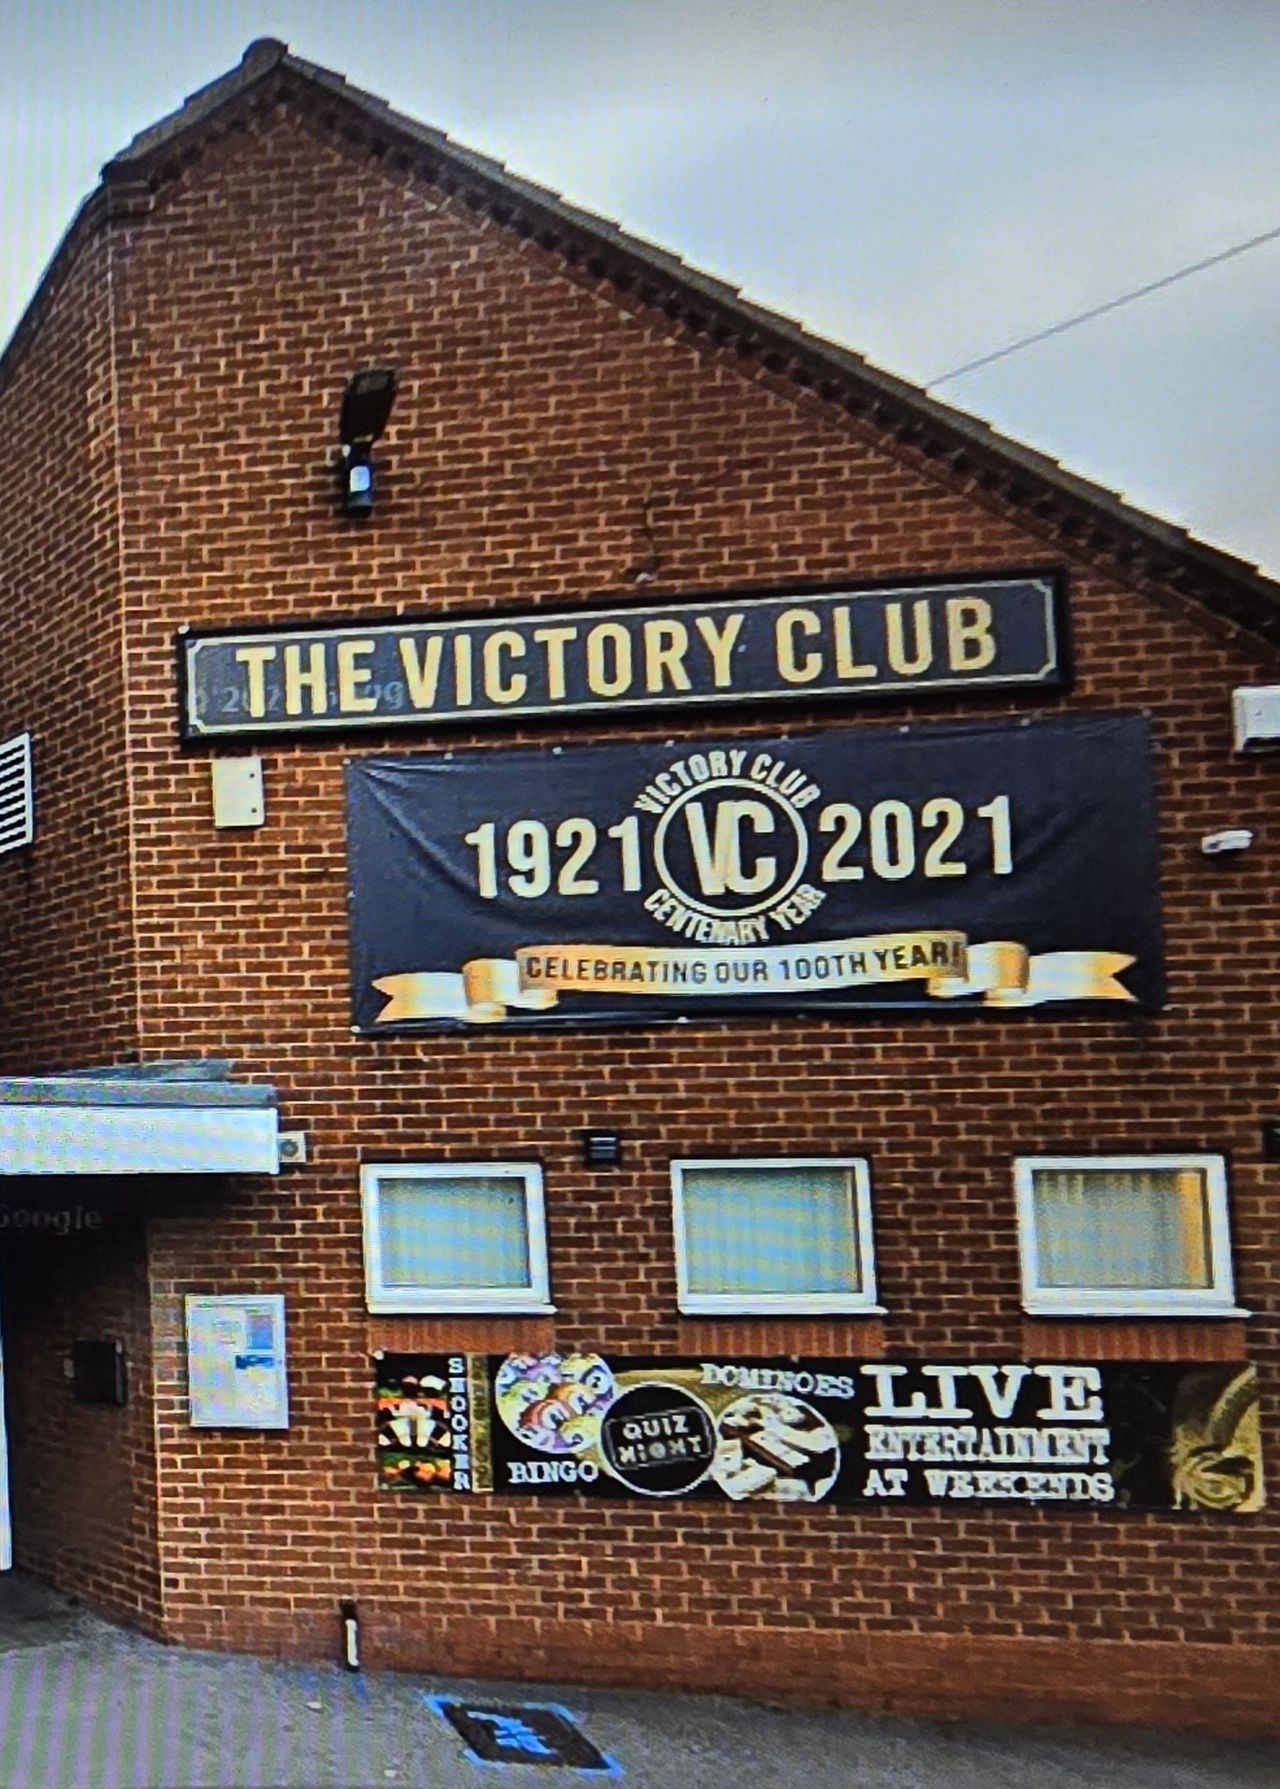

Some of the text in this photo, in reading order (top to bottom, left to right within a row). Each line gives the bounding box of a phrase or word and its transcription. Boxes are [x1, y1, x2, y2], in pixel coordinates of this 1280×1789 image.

[236, 596, 997, 718] THE VICTORY CLUB
[634, 749, 821, 814] VICTORY CLUB
[464, 816, 642, 898] 1921
[685, 799, 777, 896] VC
[818, 794, 1013, 882] 2021
[643, 883, 827, 946] CENTENARY YEAR
[527, 956, 707, 985] CELEBRATING
[714, 960, 768, 985] OUR
[779, 950, 867, 981] 100TH
[700, 1362, 855, 1399] DOMINOES
[860, 1364, 1104, 1421] LIVE
[622, 1415, 689, 1440] QUIZ
[863, 1424, 1111, 1466] ENTERTAINMENT
[506, 1460, 599, 1484] BINGO
[863, 1468, 1115, 1501] AT WEEKENDS
